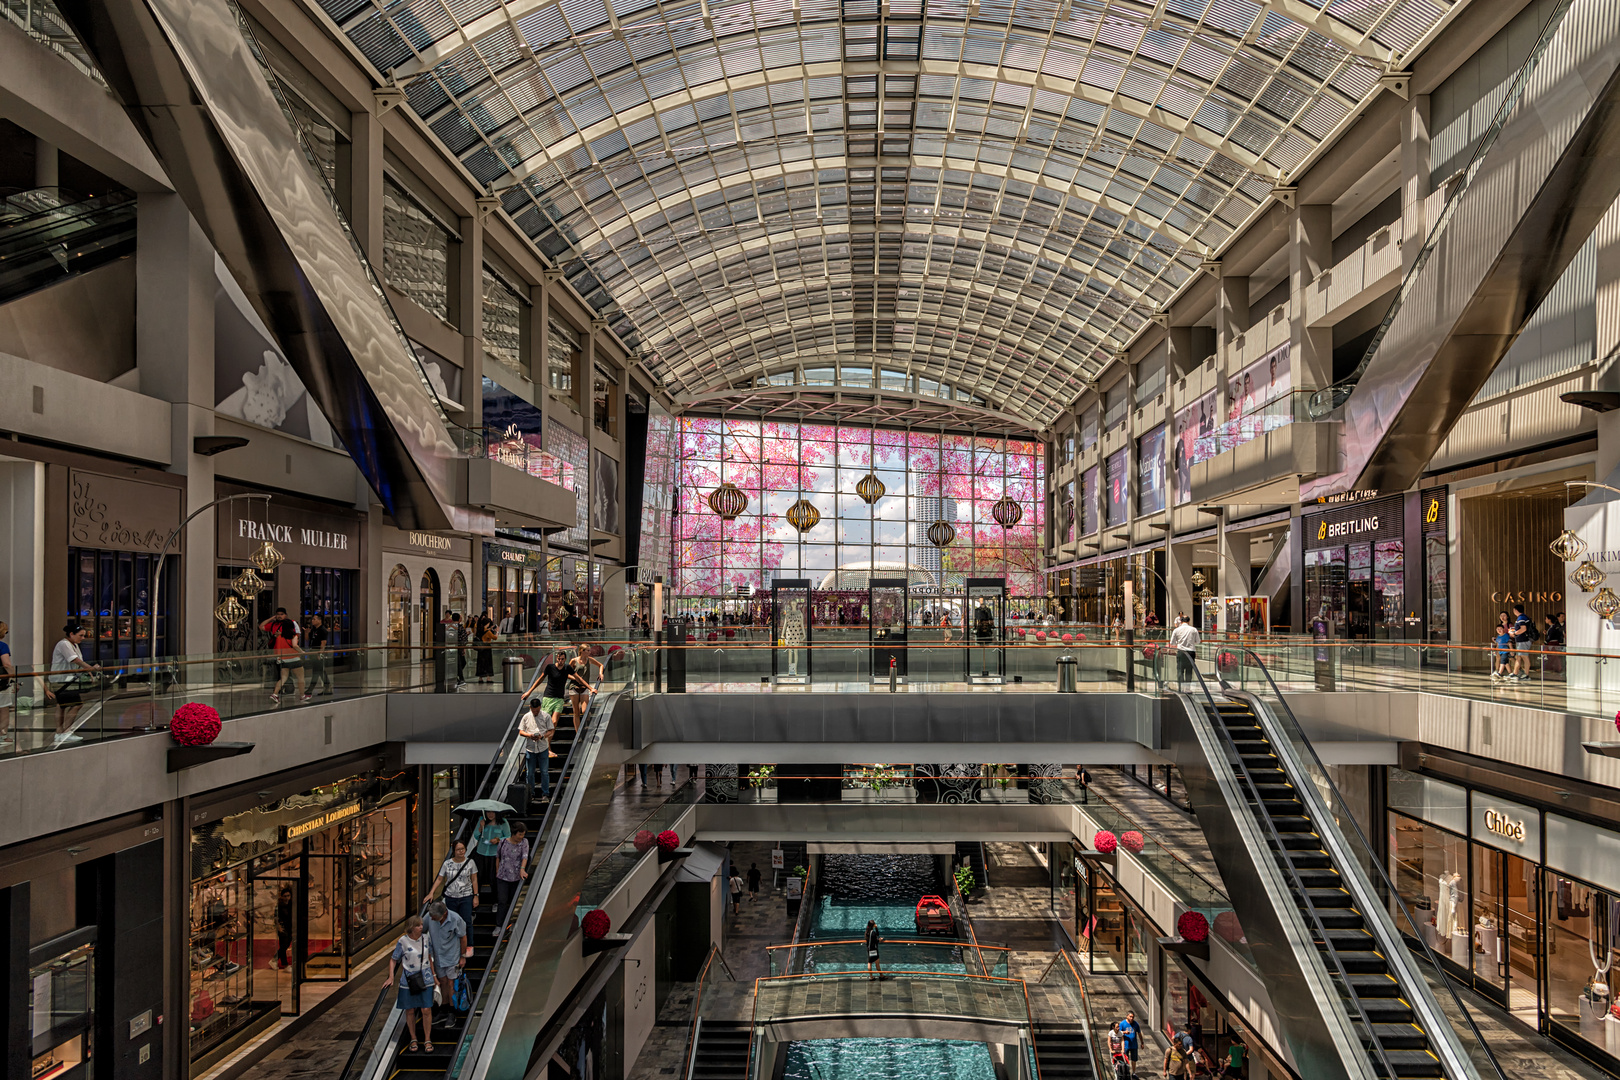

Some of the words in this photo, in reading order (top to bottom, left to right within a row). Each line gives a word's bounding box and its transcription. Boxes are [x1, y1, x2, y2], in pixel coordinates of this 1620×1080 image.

[238, 519, 293, 543] FRANCK
[300, 528, 348, 550] MULLER
[1328, 516, 1379, 537] BREITLING
[409, 531, 452, 550] BOUCHERON
[501, 550, 526, 563] CHAUMET
[1491, 591, 1562, 603] CASINO
[673, 625, 679, 636] 1
[287, 816, 324, 838] CHRISTIAN
[325, 803, 361, 824] LOUBOUTIN
[1484, 809, 1524, 841] Chloé
